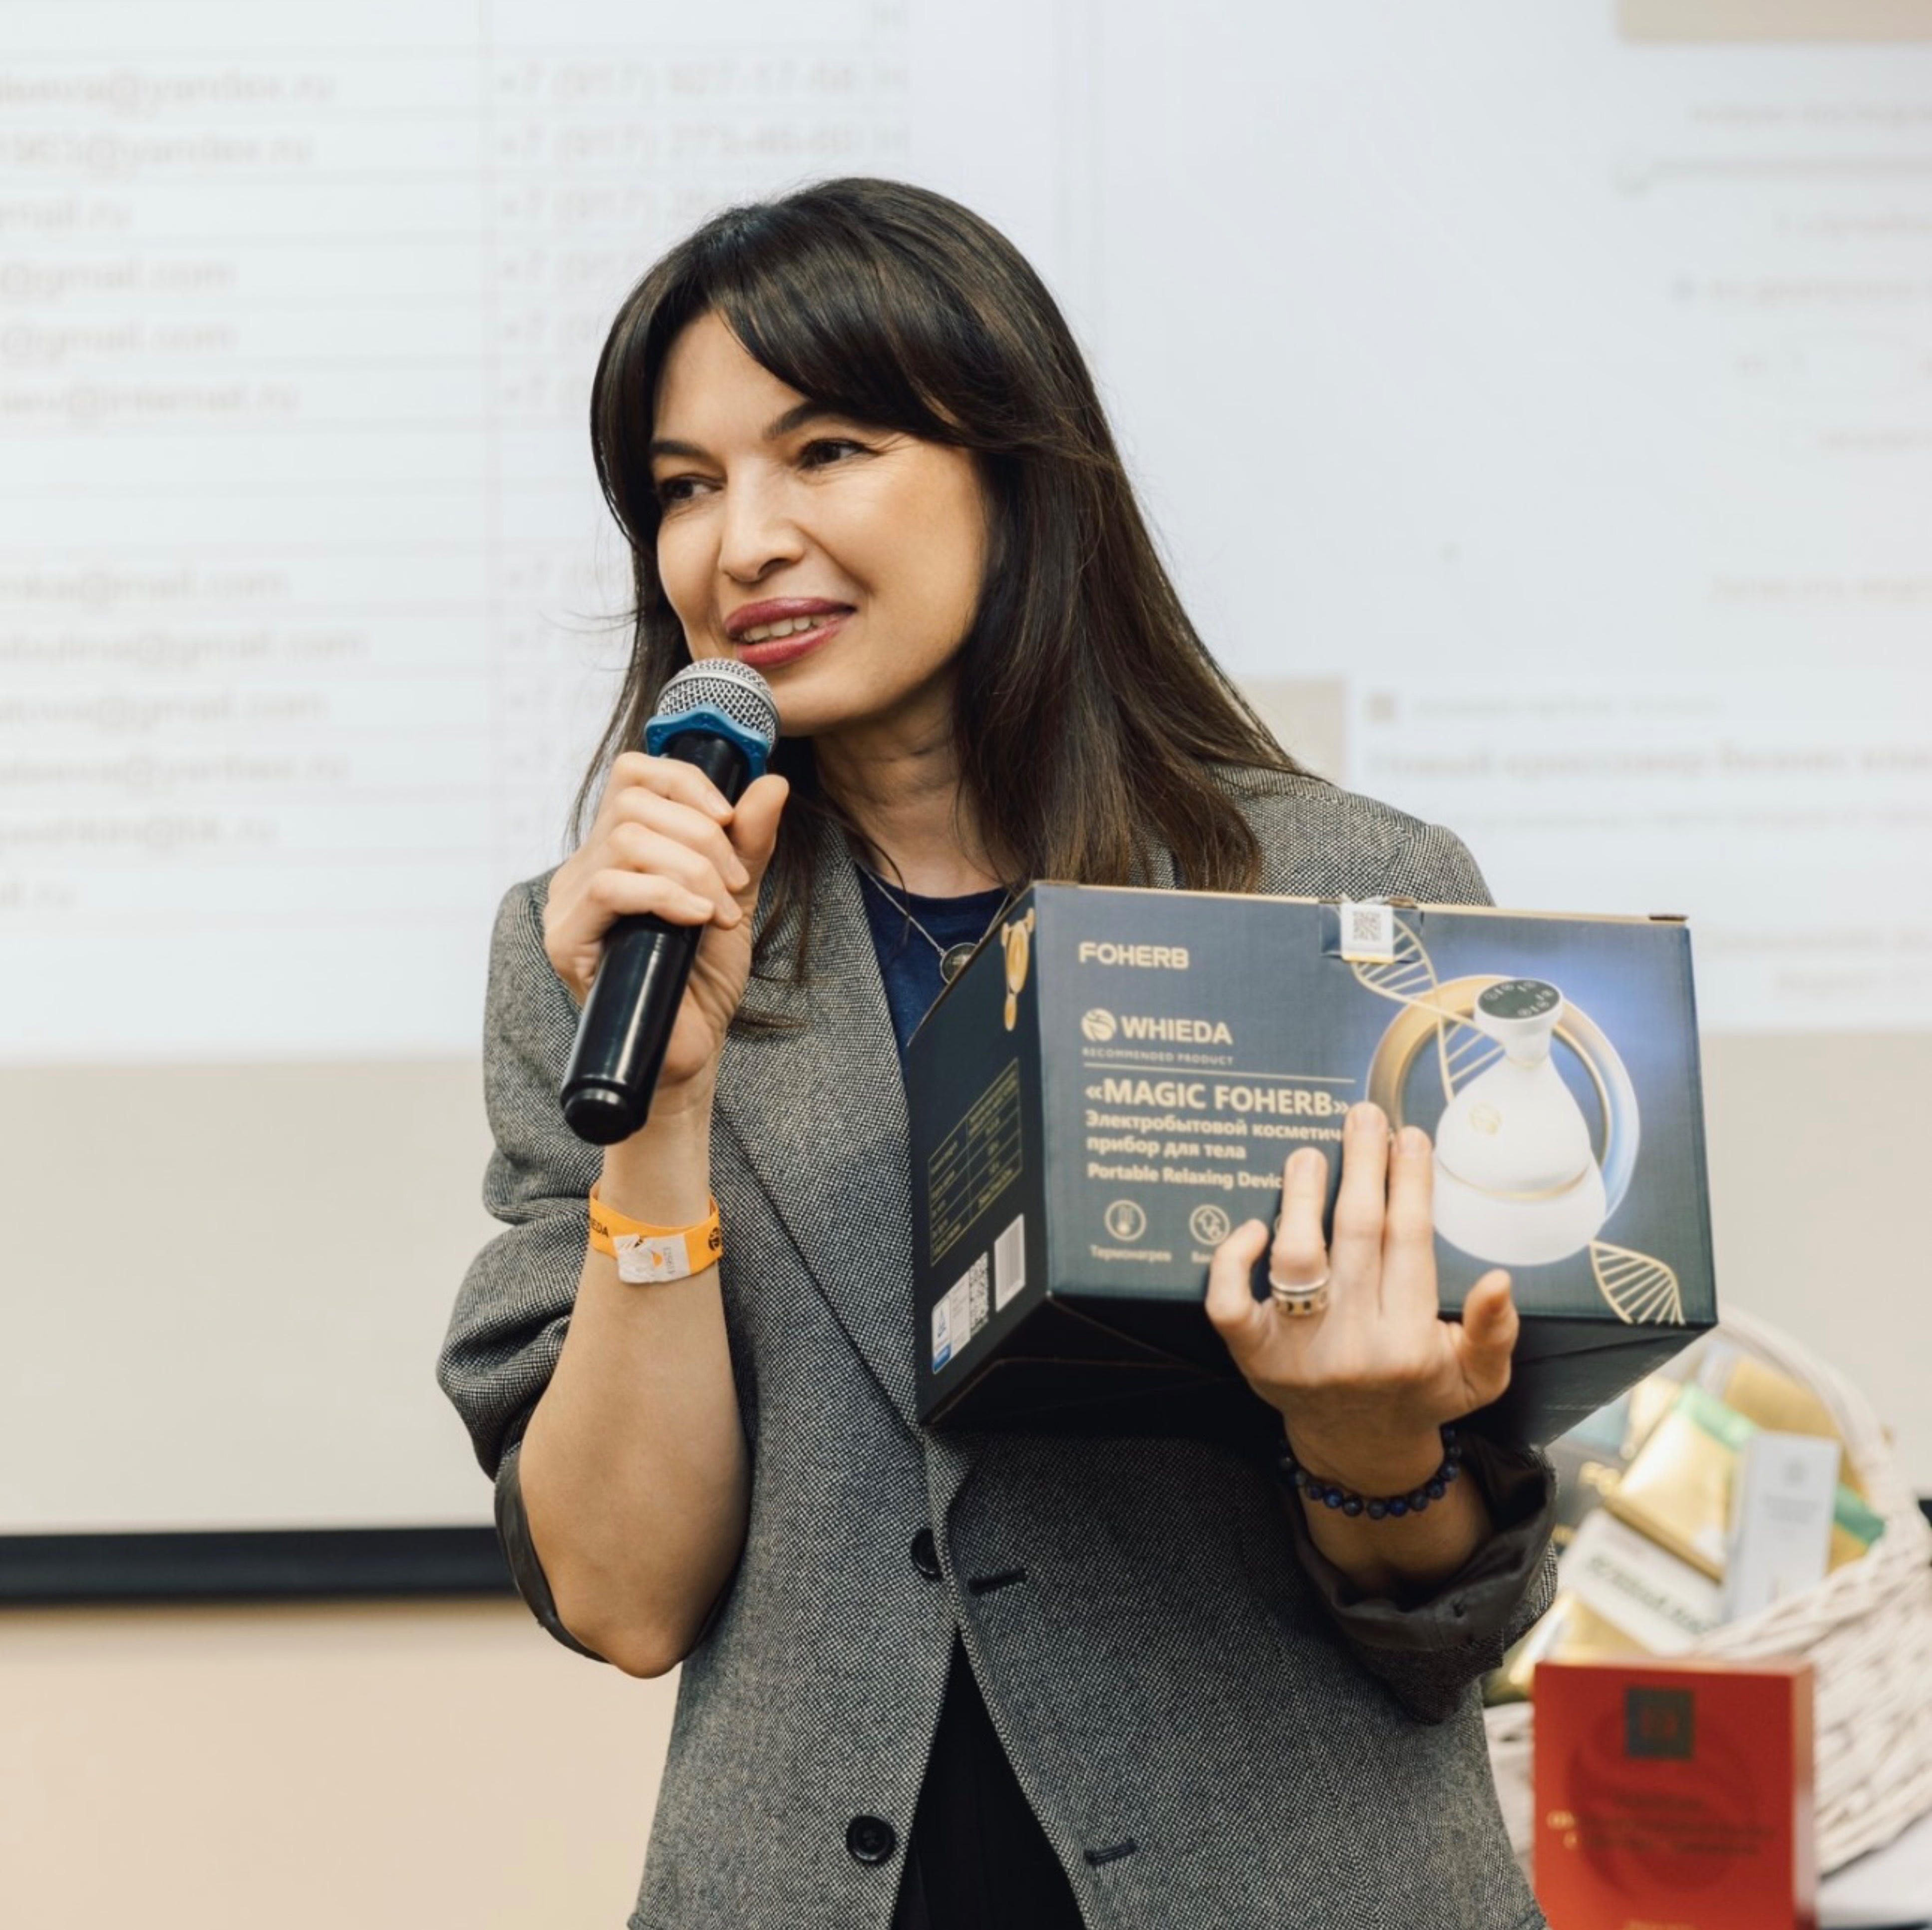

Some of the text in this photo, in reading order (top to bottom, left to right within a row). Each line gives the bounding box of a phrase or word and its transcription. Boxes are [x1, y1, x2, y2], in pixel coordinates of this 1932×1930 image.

[1079, 942, 1189, 969] FOHERB
[1120, 1016, 1233, 1045] WHIEDA
[1082, 1047, 1234, 1065] RECOMMENDED PRODUCT
[1085, 1078, 1349, 1117] «MAGIC FOHERB»
[1086, 1109, 1342, 1142] Электробытовой косметич
[1086, 1136, 1247, 1160] прибор для тела
[1087, 1162, 1284, 1190] Portable Relaxing Devic
